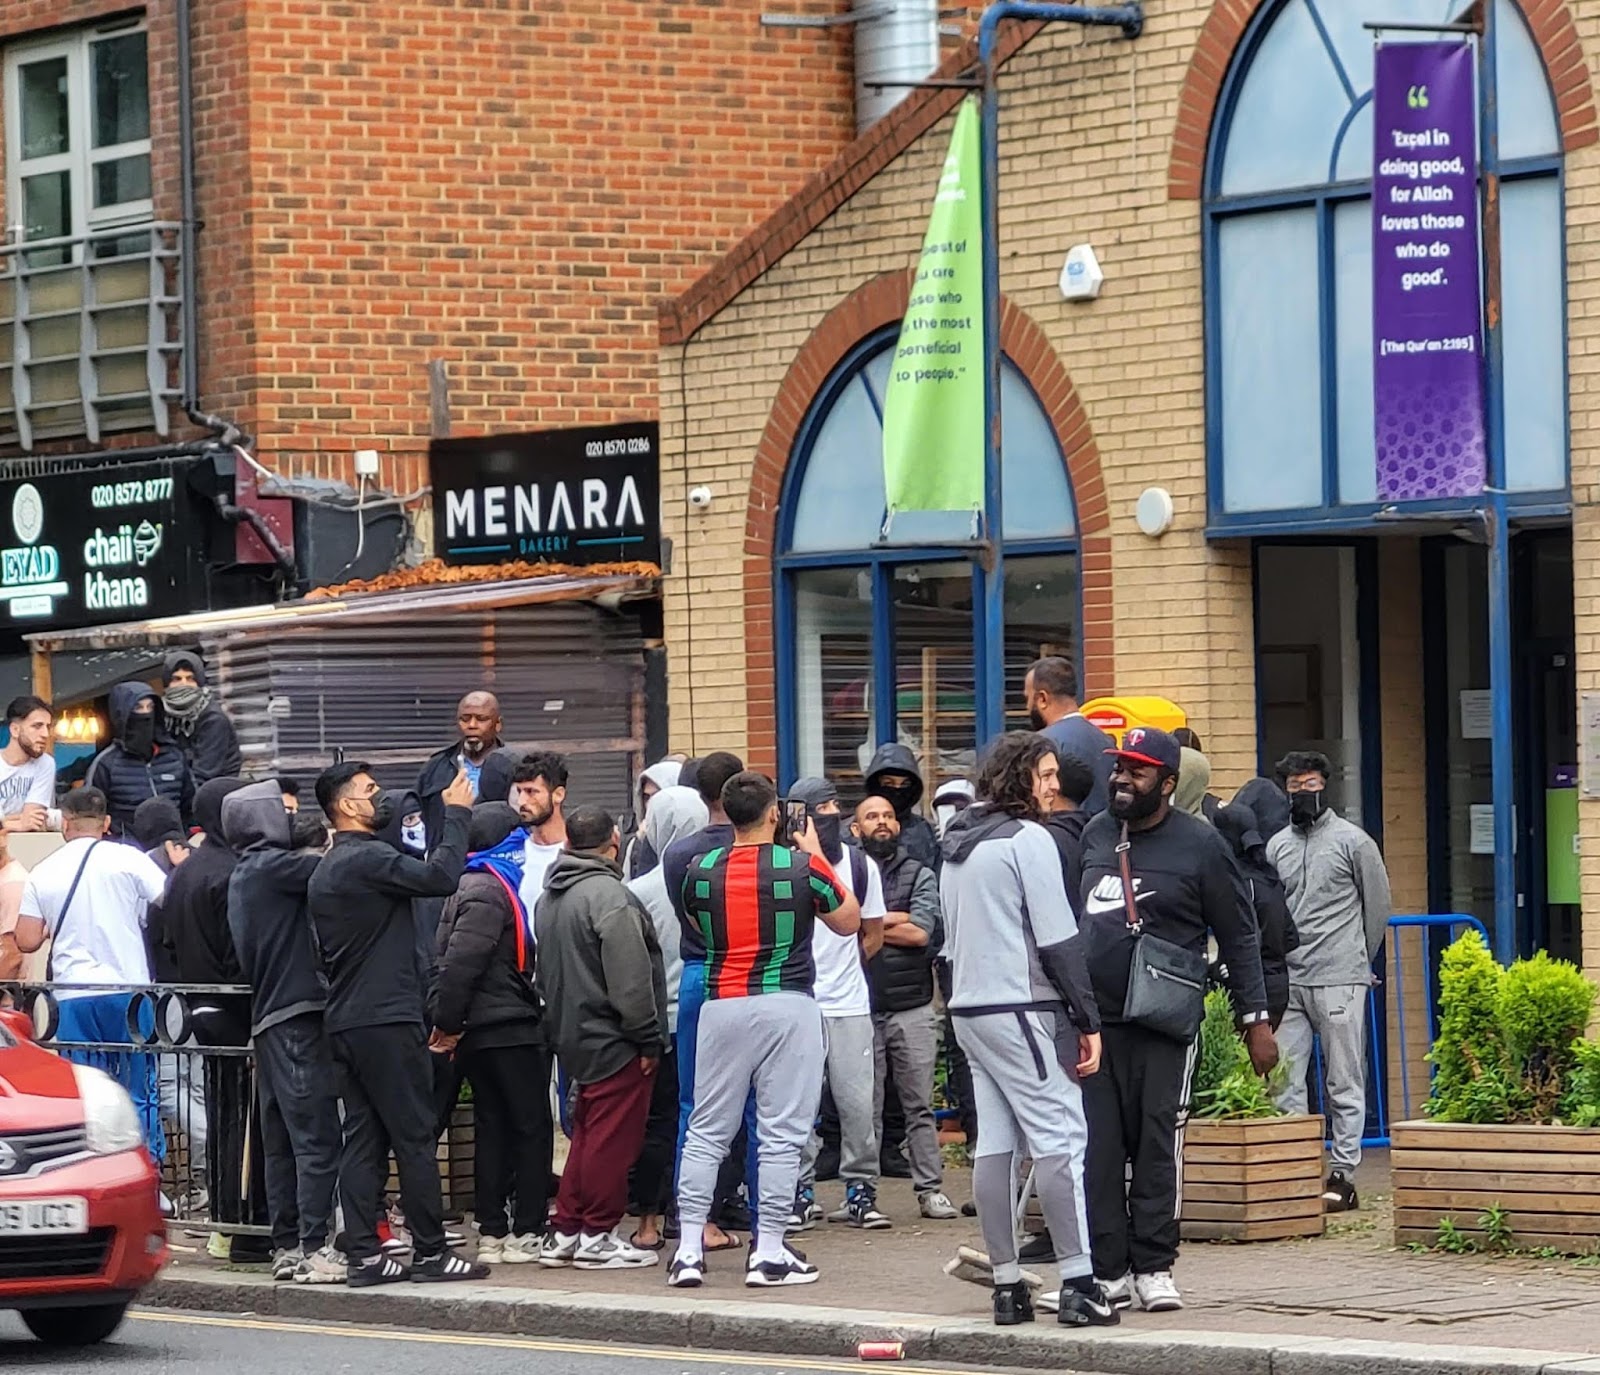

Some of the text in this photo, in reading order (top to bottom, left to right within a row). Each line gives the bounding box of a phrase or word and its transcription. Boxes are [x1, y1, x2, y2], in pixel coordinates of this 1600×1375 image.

[1433, 128, 1450, 146] in
[1380, 156, 1465, 179] doing good,
[1391, 185, 1453, 203] for Allah
[1381, 213, 1464, 231] loves those
[955, 239, 966, 253] of
[1395, 241, 1450, 258] who do
[932, 268, 954, 279] are
[938, 290, 962, 304] who
[913, 318, 937, 329] the
[940, 317, 970, 329] most
[896, 371, 910, 382] to
[586, 437, 650, 457] 020 8570 0286
[91, 478, 173, 508] 020 8572 8777
[446, 475, 645, 538] MENARA
[84, 525, 133, 567] chaii
[519, 535, 569, 555] BAKERY
[1, 545, 59, 585] EYAD
[85, 571, 147, 609] khana
